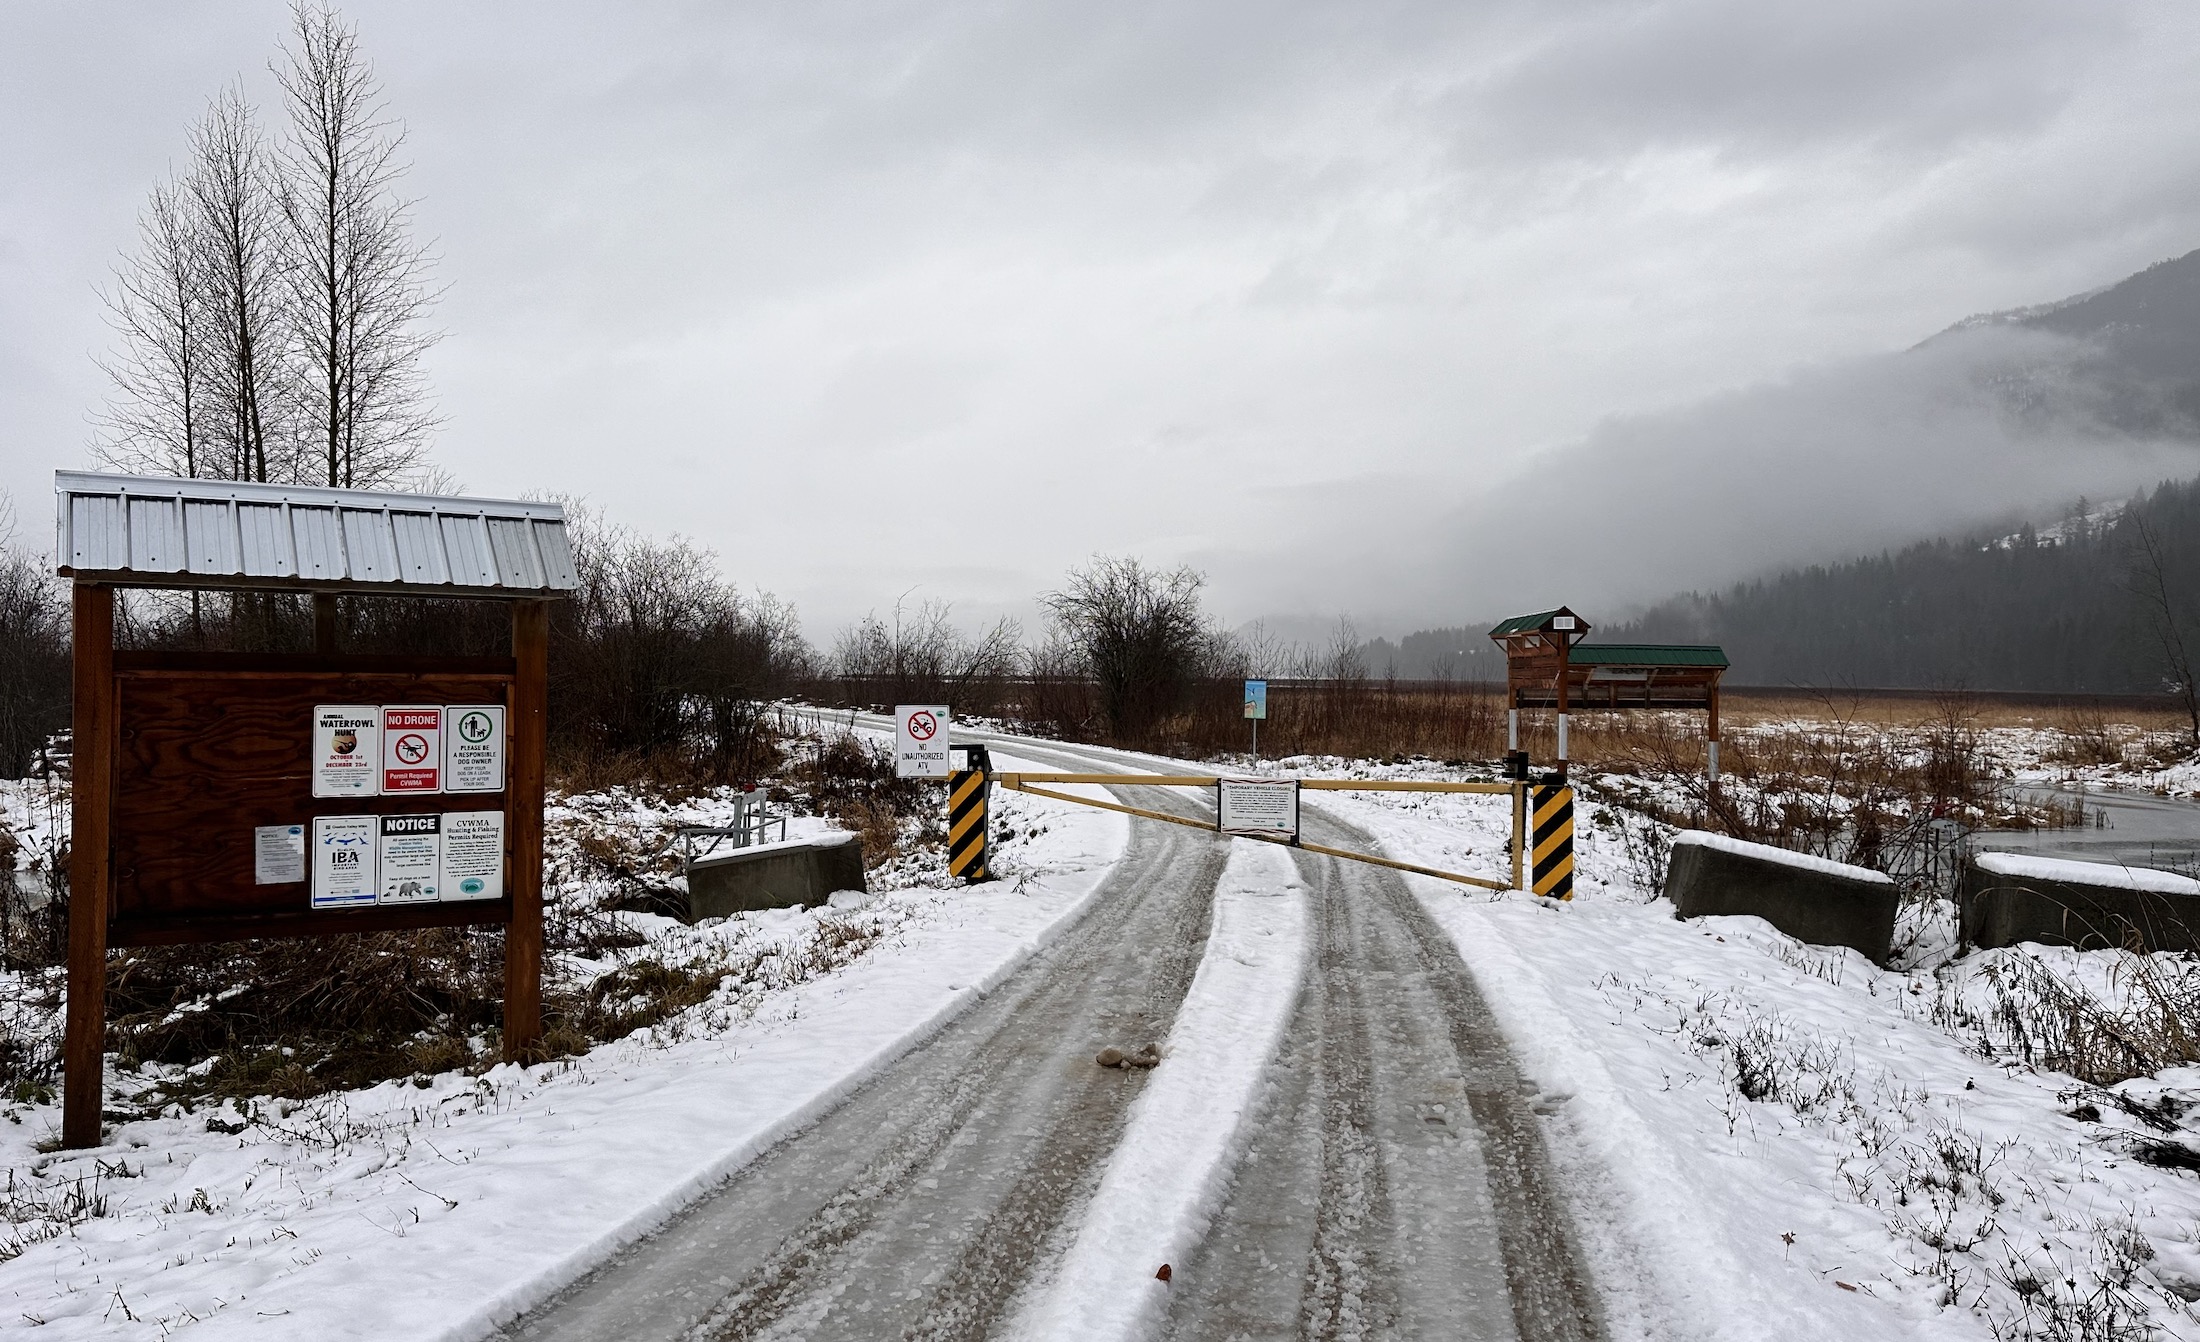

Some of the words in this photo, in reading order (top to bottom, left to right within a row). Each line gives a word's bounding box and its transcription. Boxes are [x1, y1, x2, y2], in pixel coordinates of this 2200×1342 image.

[388, 716, 402, 724] NO
[404, 716, 436, 724] DRONE
[386, 819, 436, 831] NOTICE
[332, 852, 360, 863] IBA
